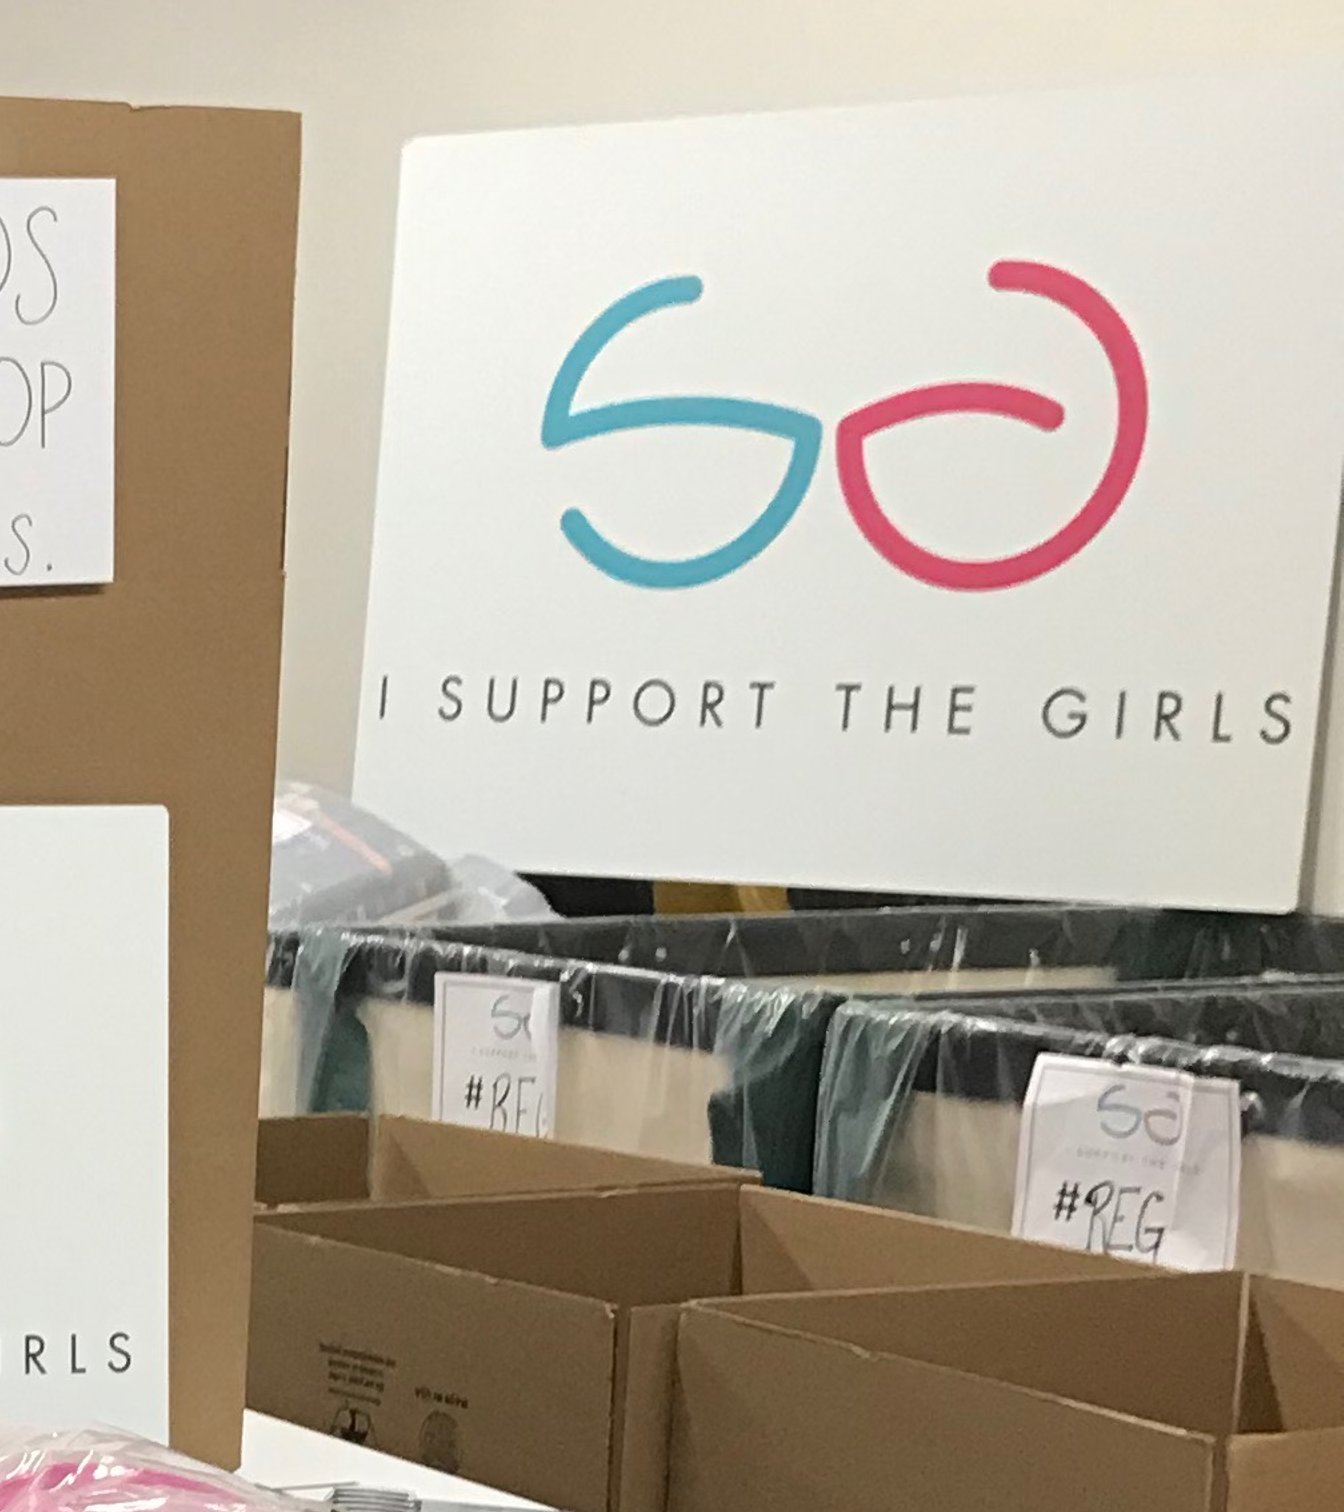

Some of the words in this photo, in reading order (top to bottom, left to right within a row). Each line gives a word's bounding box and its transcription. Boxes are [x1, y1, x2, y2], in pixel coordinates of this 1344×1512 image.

[379, 675, 389, 720] I
[437, 675, 775, 729] SUPPORT
[835, 682, 976, 736] THE
[1041, 687, 1292, 746] GIRLS
[1053, 1179, 1166, 1265] #REG
